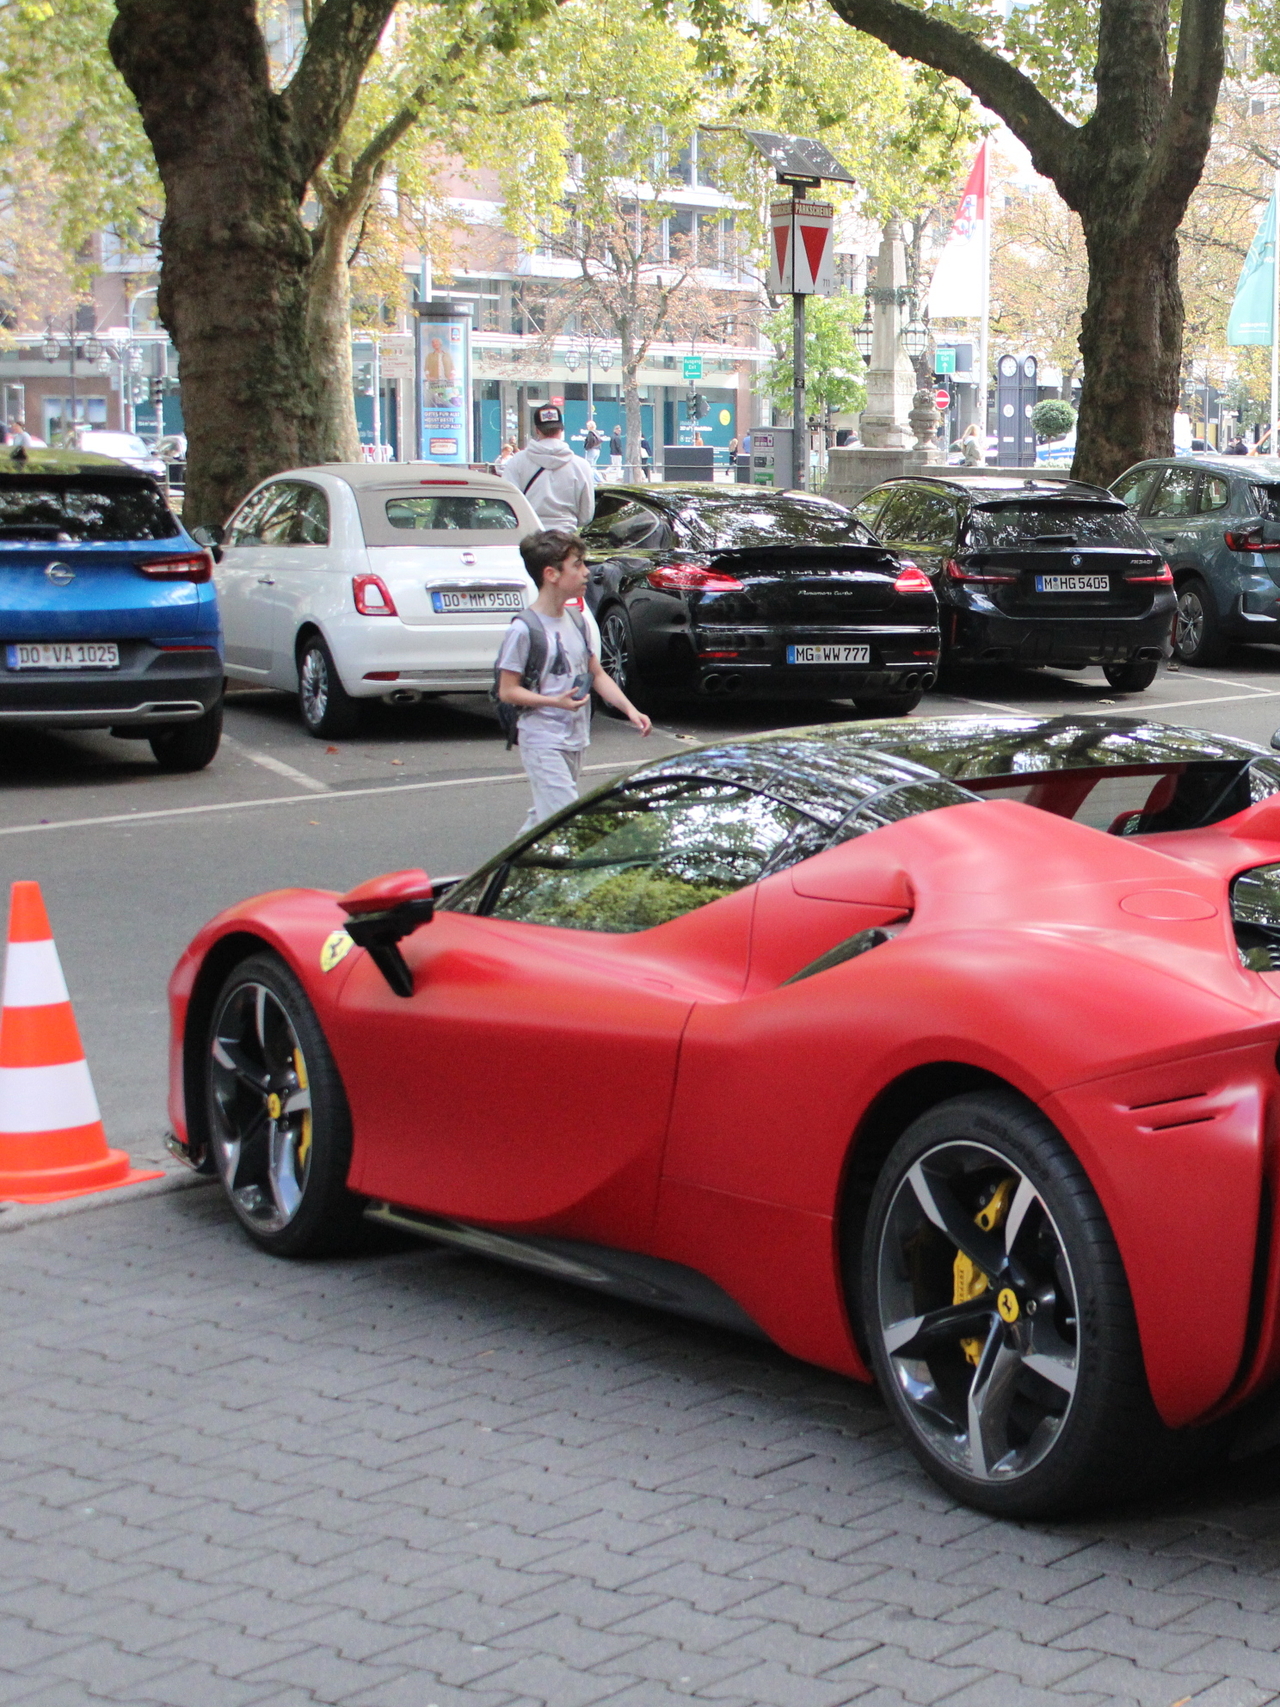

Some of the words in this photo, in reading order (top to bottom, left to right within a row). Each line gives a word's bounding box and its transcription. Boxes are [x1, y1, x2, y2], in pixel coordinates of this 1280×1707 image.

[796, 204, 833, 217] PARKSCHEINE
[1044, 579, 1053, 590] M
[1060, 578, 1076, 589] HG
[1079, 577, 1108, 589] 5405
[443, 594, 460, 607] DO
[469, 593, 487, 606] MM
[489, 593, 520, 606] 9508
[20, 647, 40, 663] DO
[53, 646, 73, 662] VA
[78, 646, 116, 662] 1025
[796, 648, 814, 661] MG
[823, 648, 840, 661] WW
[844, 648, 868, 661] 777
